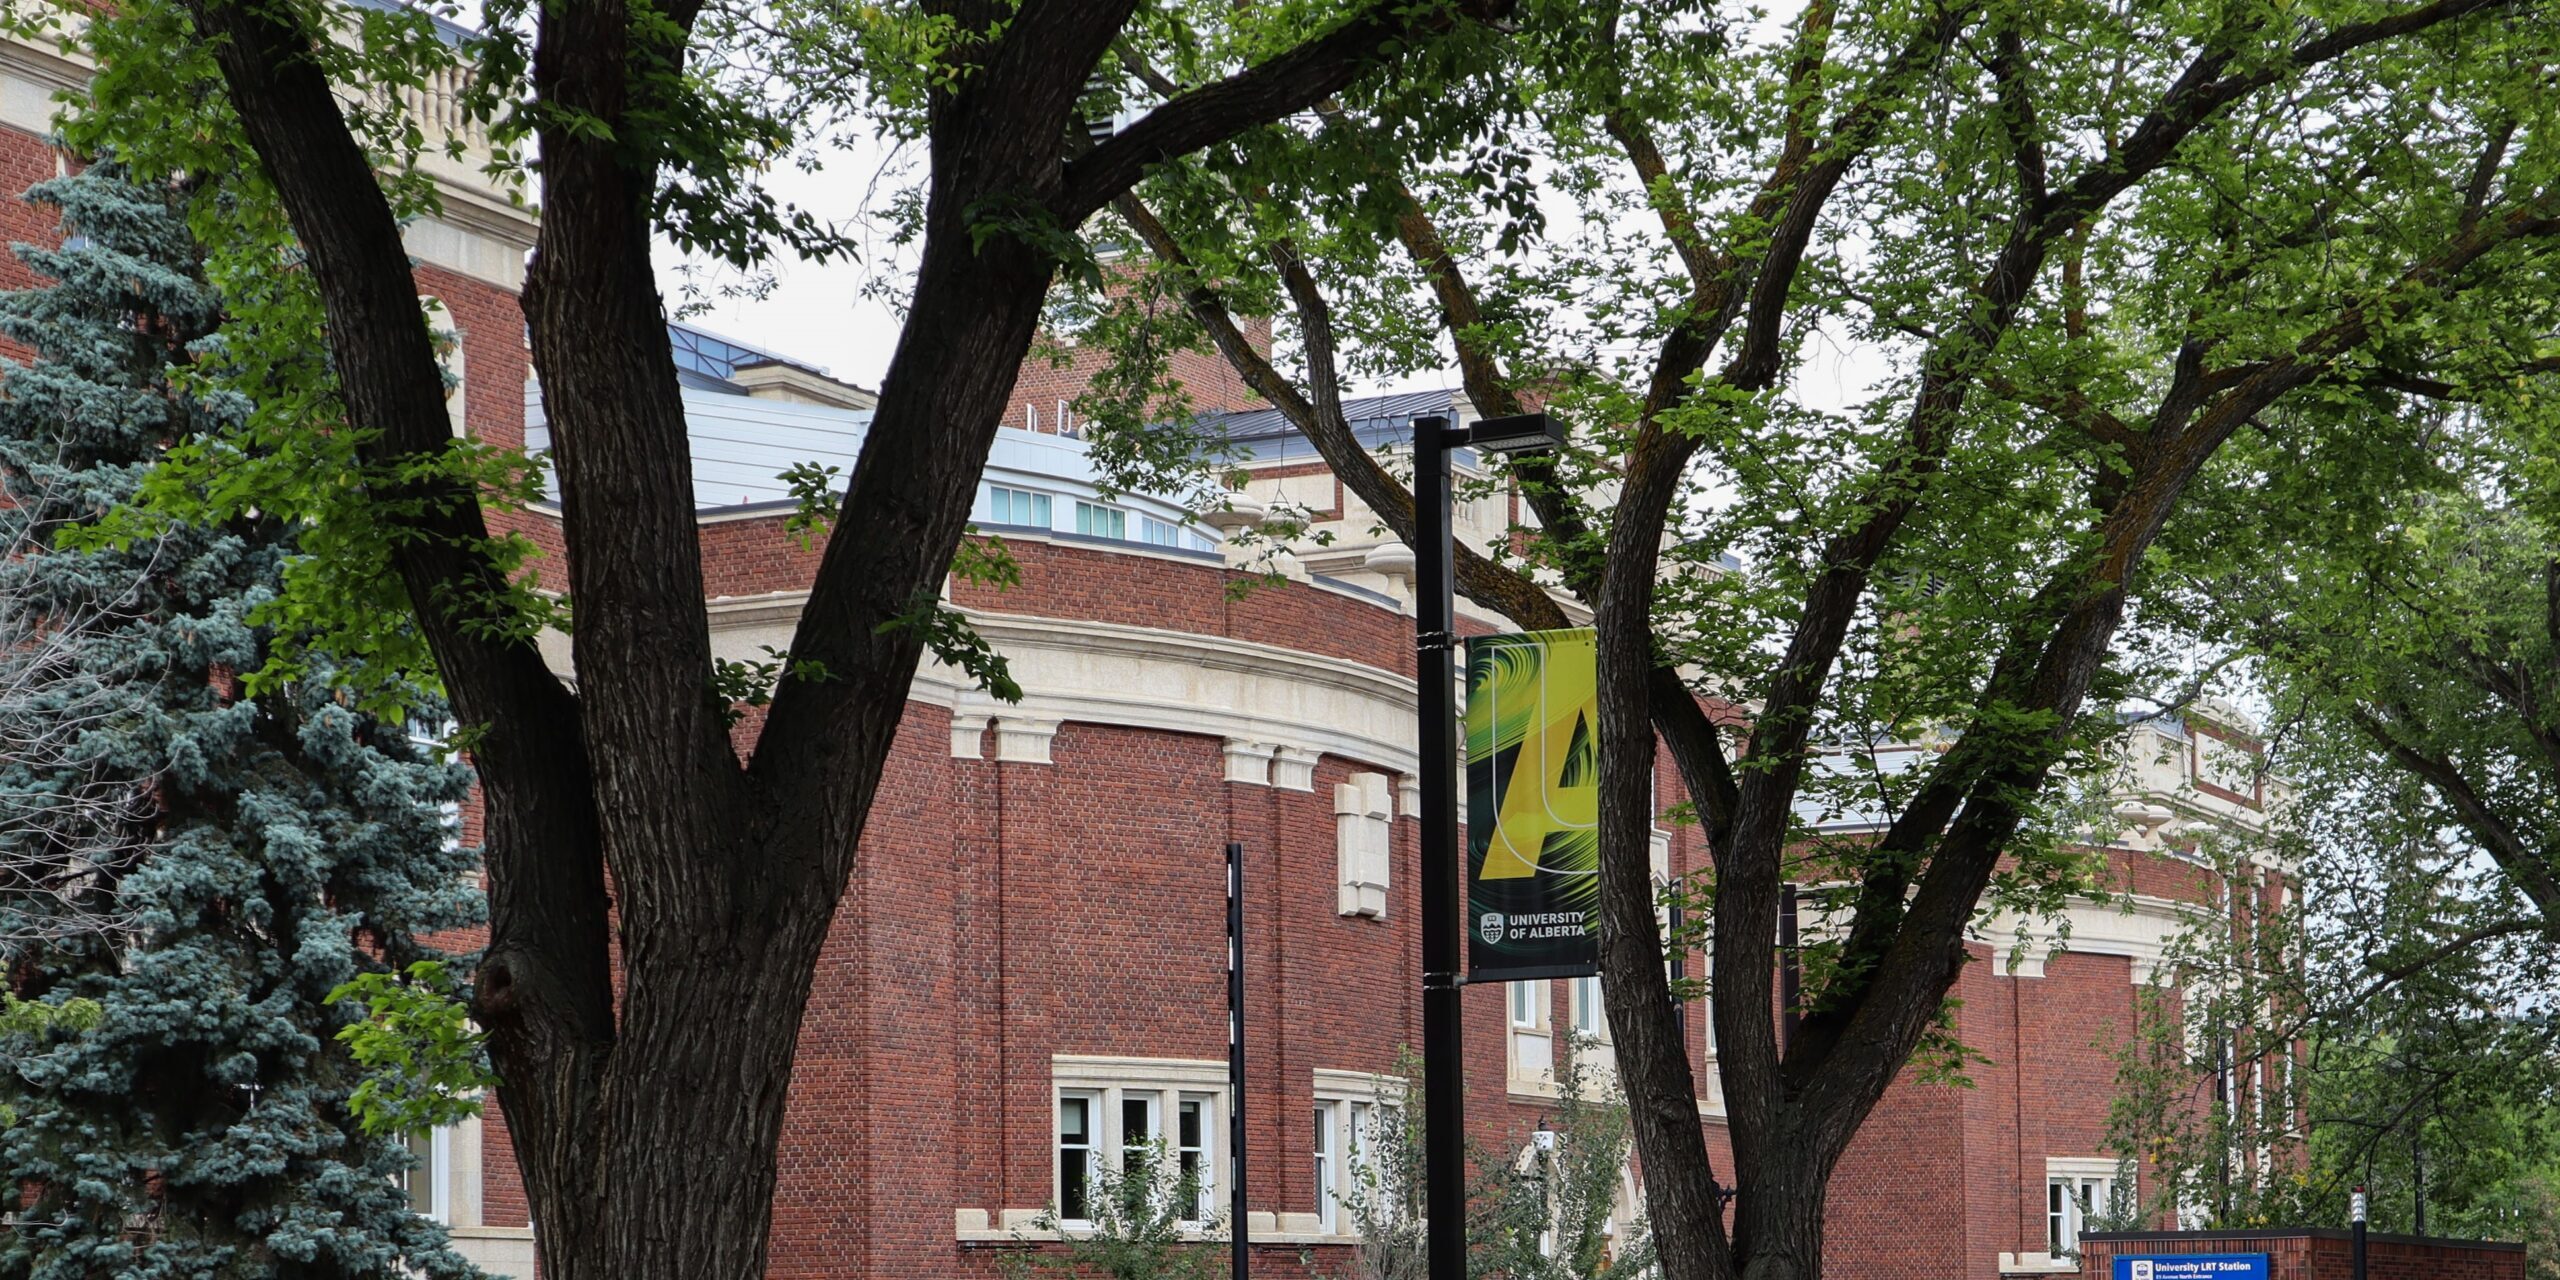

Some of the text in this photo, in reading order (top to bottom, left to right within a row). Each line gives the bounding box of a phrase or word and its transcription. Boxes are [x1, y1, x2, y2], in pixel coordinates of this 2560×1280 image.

[1509, 911, 1586, 926] UNIVERSITY
[1509, 924, 1586, 940] OF ALBERTA
[2155, 1261, 2251, 1274] University LRT Station
